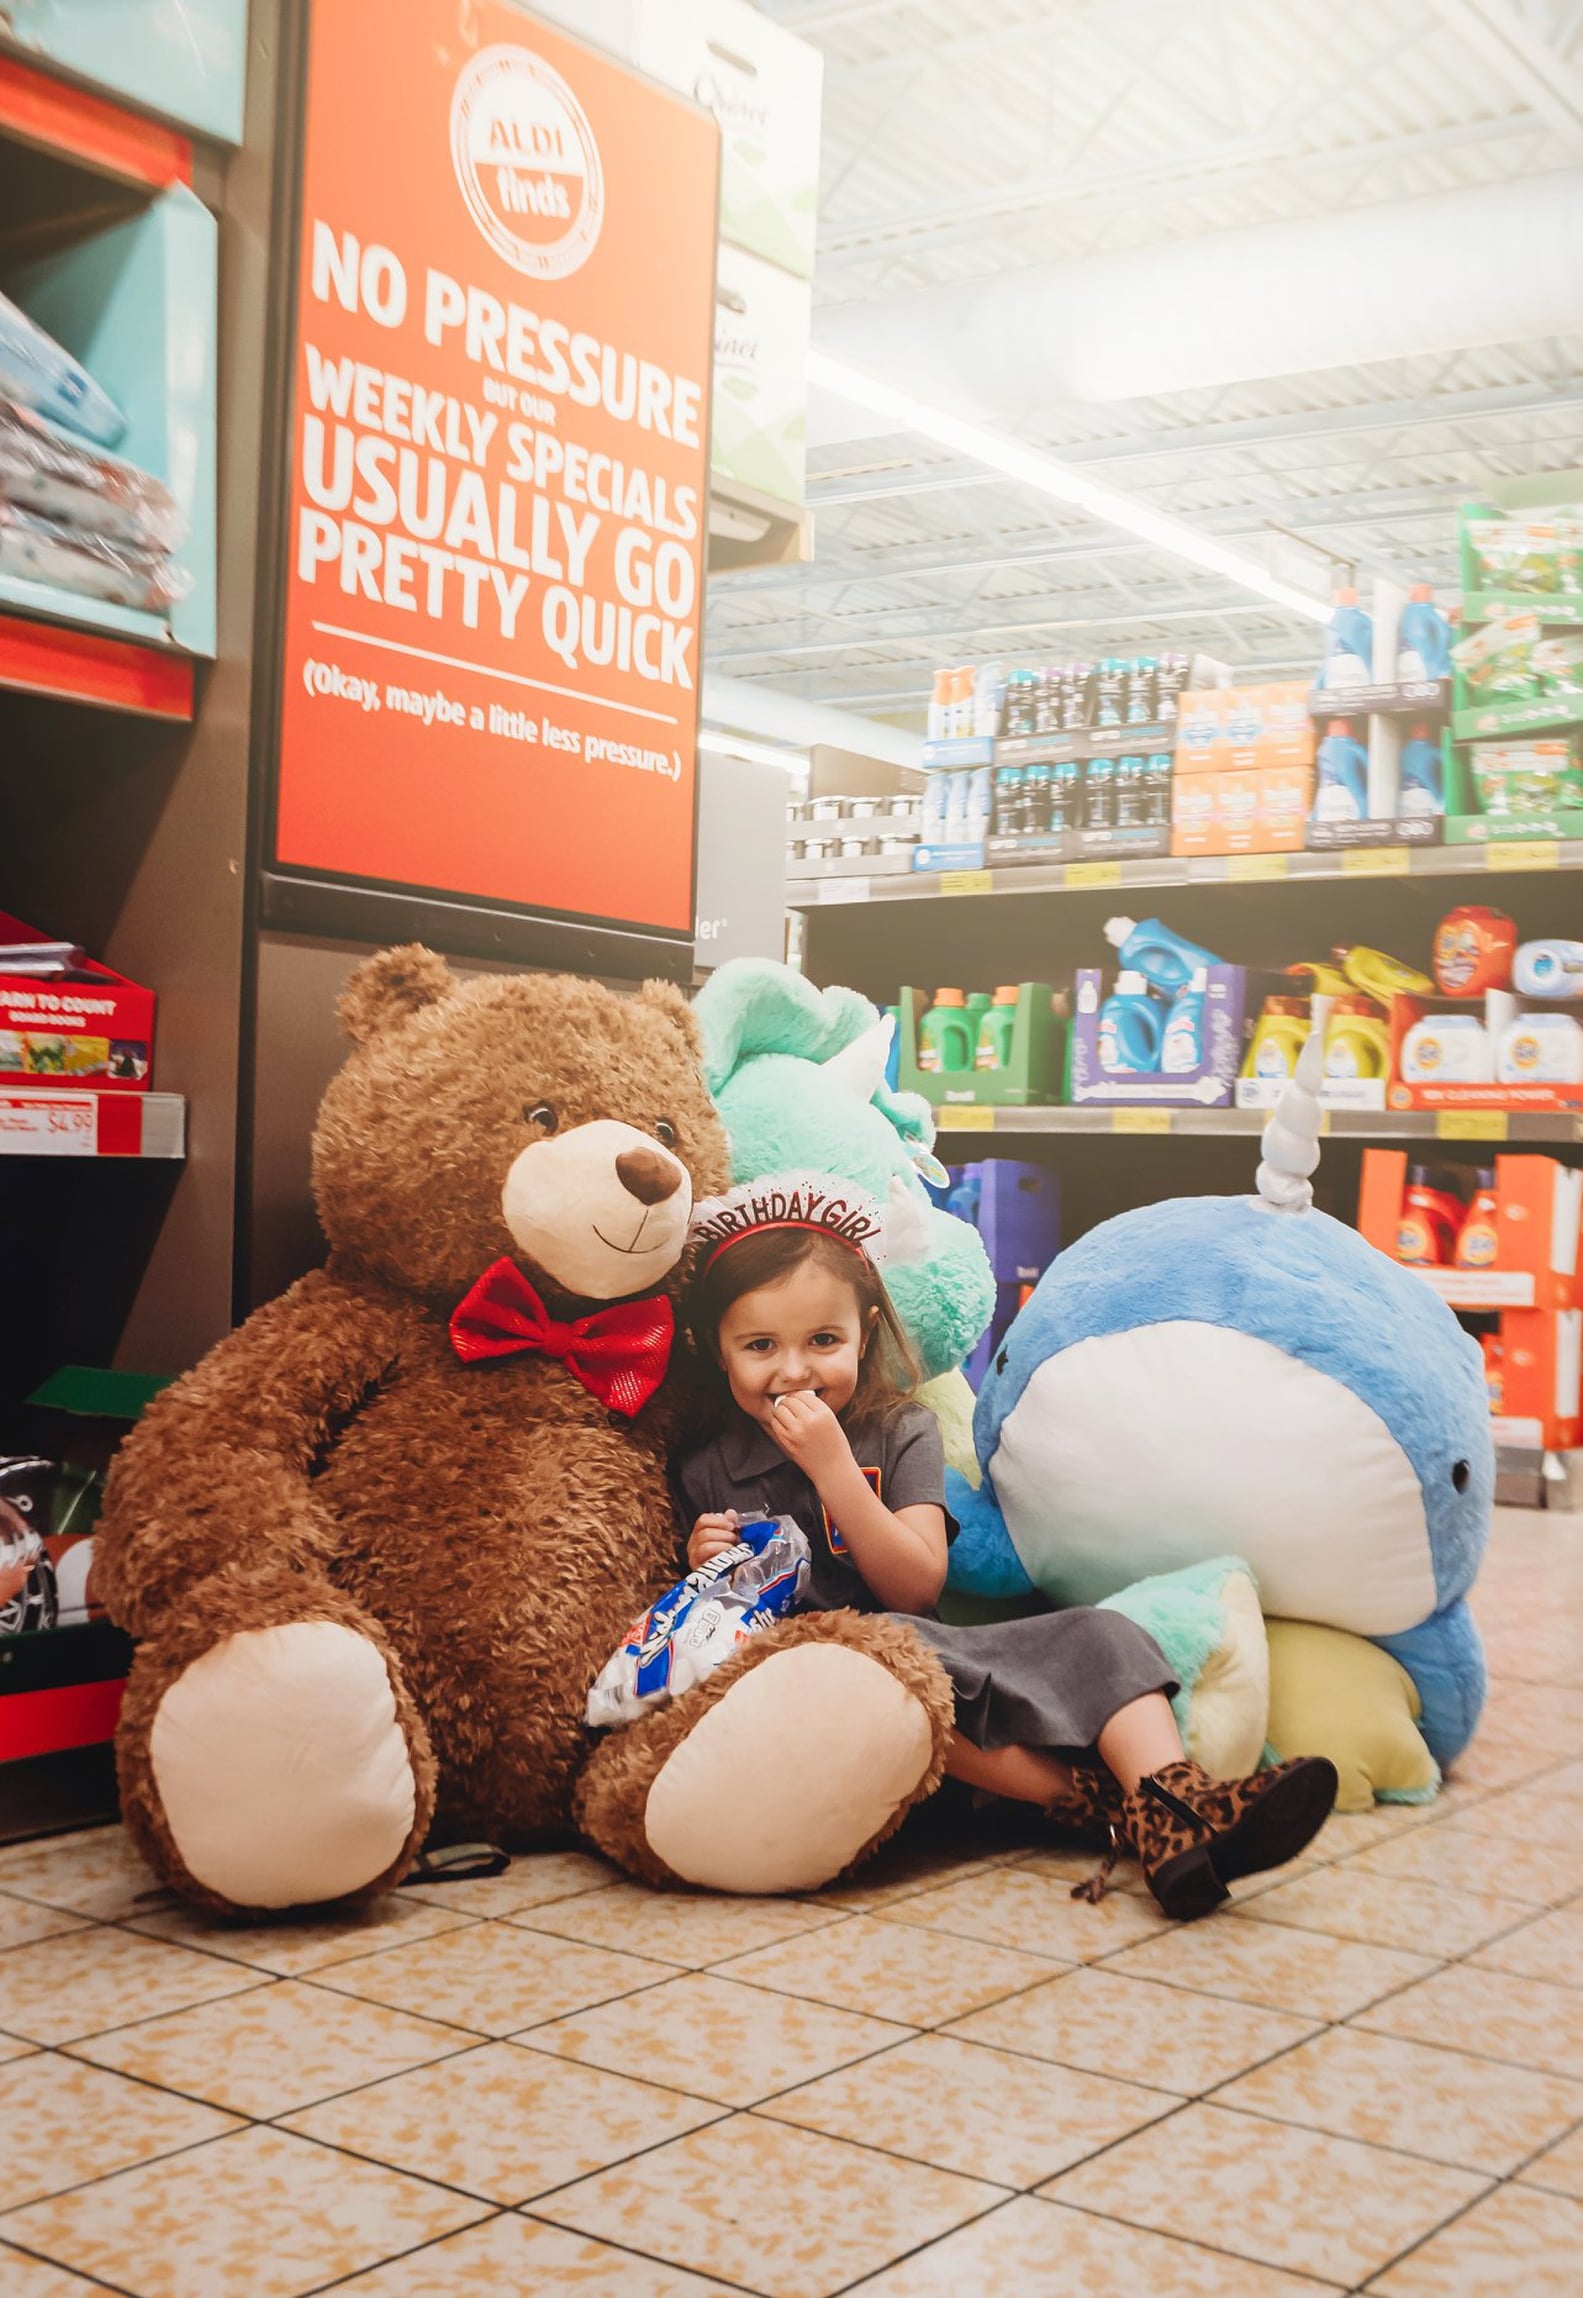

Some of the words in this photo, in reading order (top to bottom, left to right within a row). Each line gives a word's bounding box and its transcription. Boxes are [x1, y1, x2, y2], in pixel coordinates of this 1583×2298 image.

[489, 117, 564, 157] ALDI
[497, 165, 571, 219] finds
[312, 218, 407, 328] NO
[424, 266, 701, 450] PRESSURE
[305, 342, 498, 468] WEEKLY
[506, 421, 698, 541] SPECIALS
[483, 376, 518, 411] BUT
[519, 390, 556, 426] OUR
[302, 414, 601, 587] USUALLY
[614, 527, 695, 620] GO
[298, 511, 530, 640] PRETTY
[542, 586, 694, 690] QUICK
[303, 658, 381, 712] (Okay,
[386, 685, 466, 726] maybe
[469, 706, 484, 731] a
[488, 703, 538, 743] little
[542, 717, 580, 754] less
[584, 735, 681, 783] pressure.)
[37, 993, 60, 1012] TO
[61, 996, 117, 1016] COUNT
